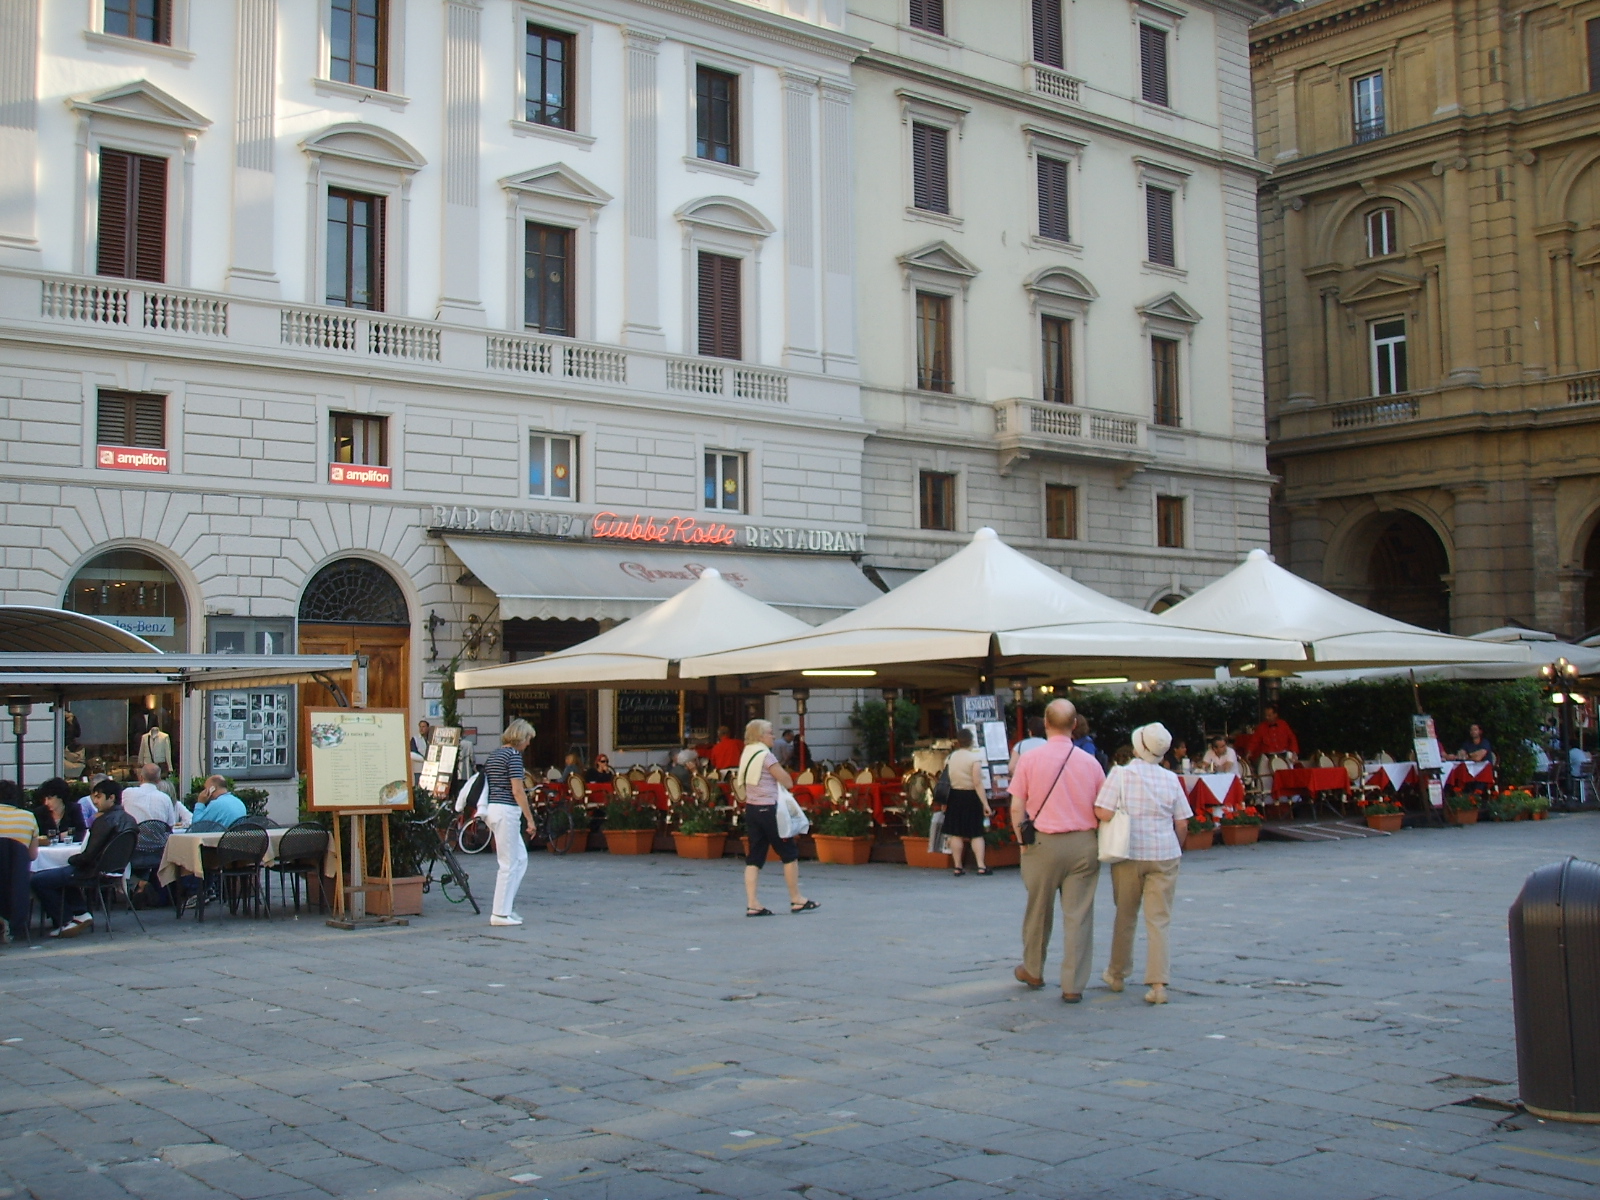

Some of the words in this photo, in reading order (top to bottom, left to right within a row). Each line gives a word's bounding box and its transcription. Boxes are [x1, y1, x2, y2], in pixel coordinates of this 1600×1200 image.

[117, 453, 167, 466] amplifon
[346, 470, 389, 483] amplifon
[431, 505, 480, 530] BAR
[592, 511, 669, 542] Giubbe
[667, 516, 736, 545] Rosse
[745, 526, 866, 552] RESTAURANT
